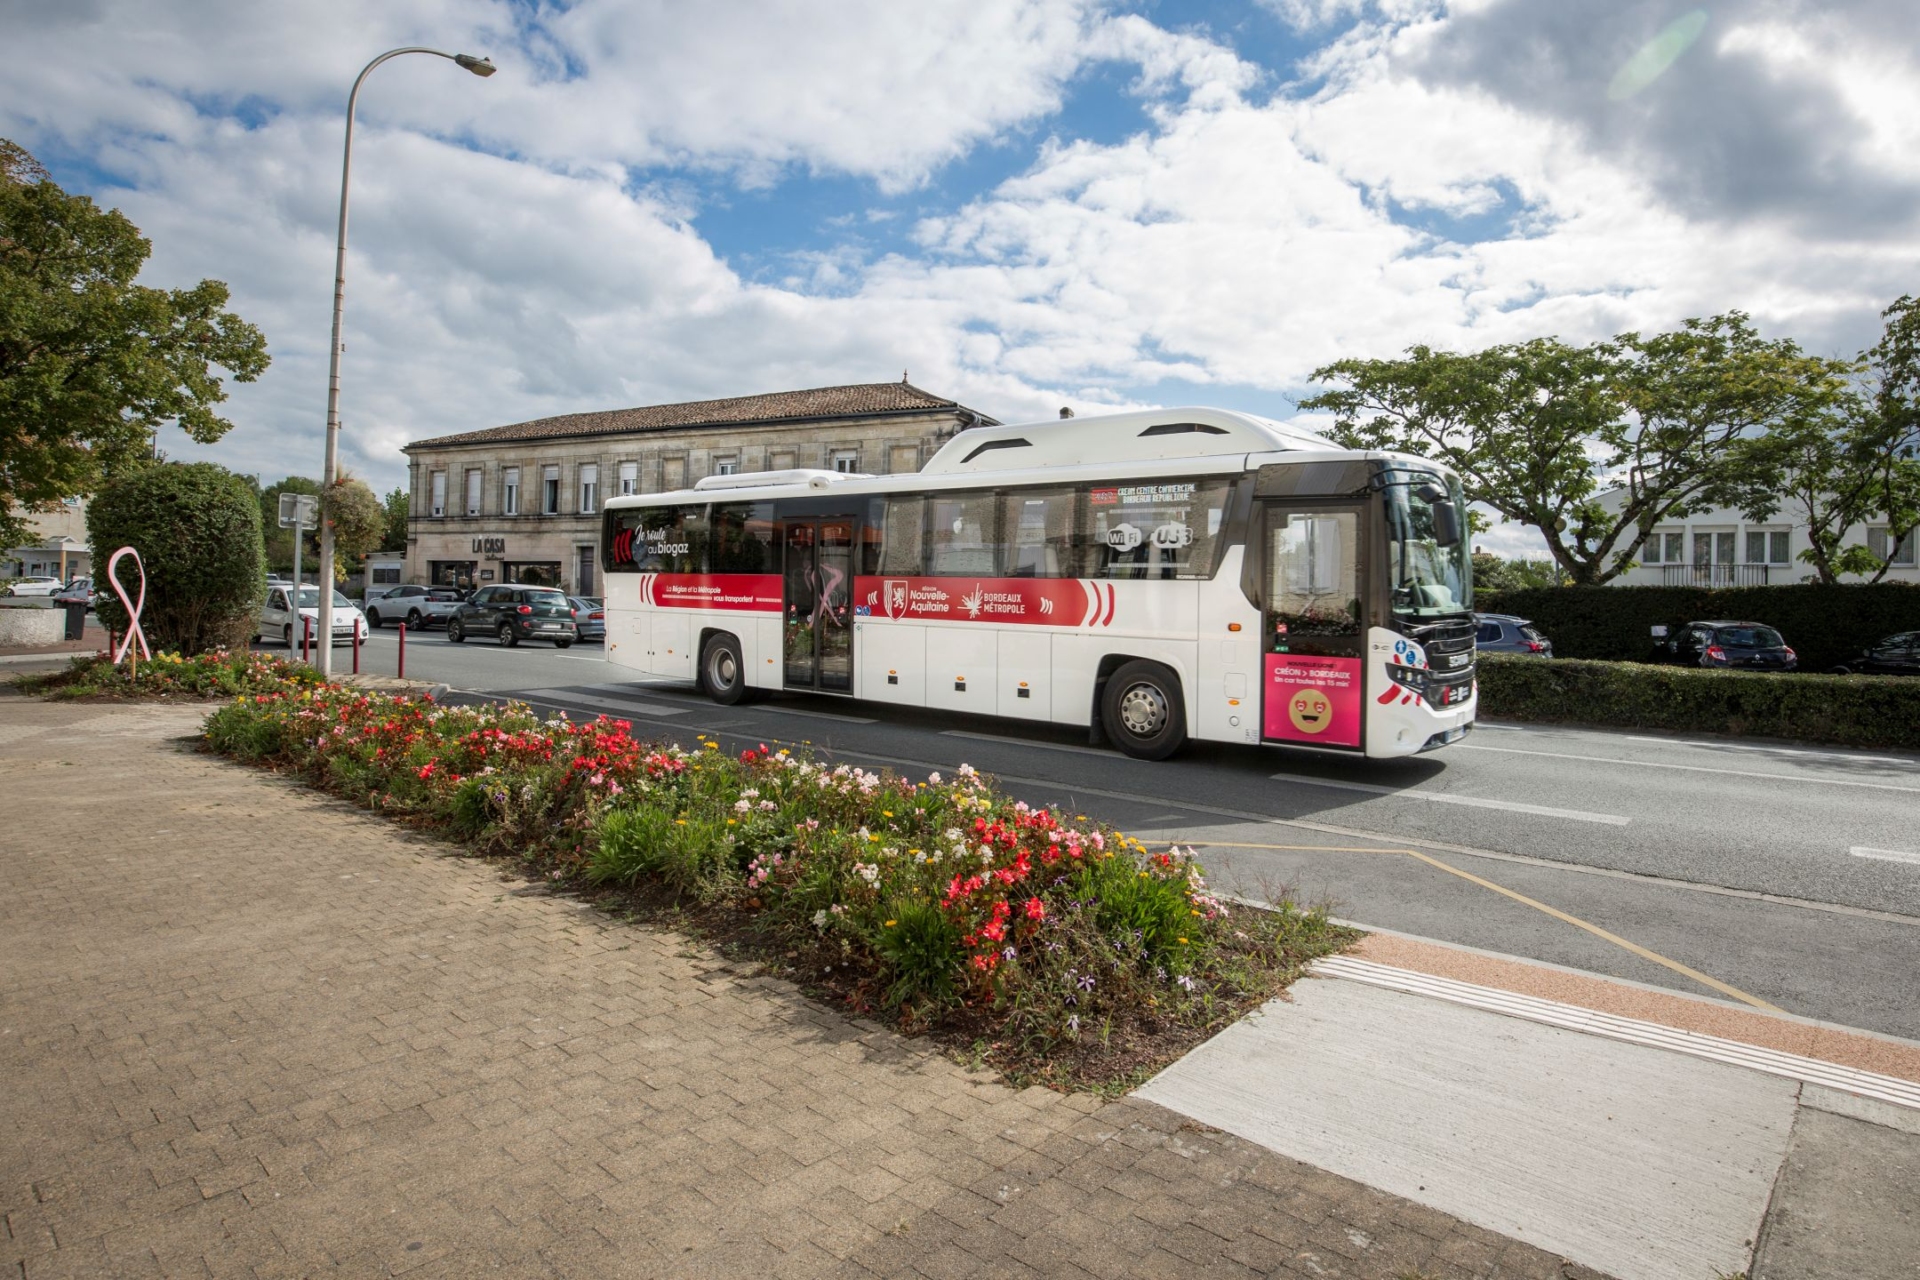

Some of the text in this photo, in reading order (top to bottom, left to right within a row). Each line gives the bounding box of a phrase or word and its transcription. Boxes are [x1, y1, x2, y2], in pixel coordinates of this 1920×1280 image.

[1136, 486, 1158, 495] CENTRE
[1158, 484, 1196, 494] COMMERCIAL
[1123, 494, 1152, 504] BORDEAUX
[1152, 493, 1190, 502] REPUBLIQUE
[635, 524, 666, 544] Je roule
[472, 538, 505, 553] LA CASA
[648, 541, 688, 557] au biogaz
[672, 586, 687, 594] Région
[698, 586, 721, 594] Métropole
[910, 590, 949, 601] Nouvelle-
[725, 595, 753, 604] transportent
[984, 593, 1021, 603] BORDEAUX
[910, 601, 949, 614] Aquitaine
[984, 602, 1025, 614] MÉTROPOLE
[1274, 667, 1300, 676] CRÉON
[1309, 670, 1350, 679] BORDEAUX
